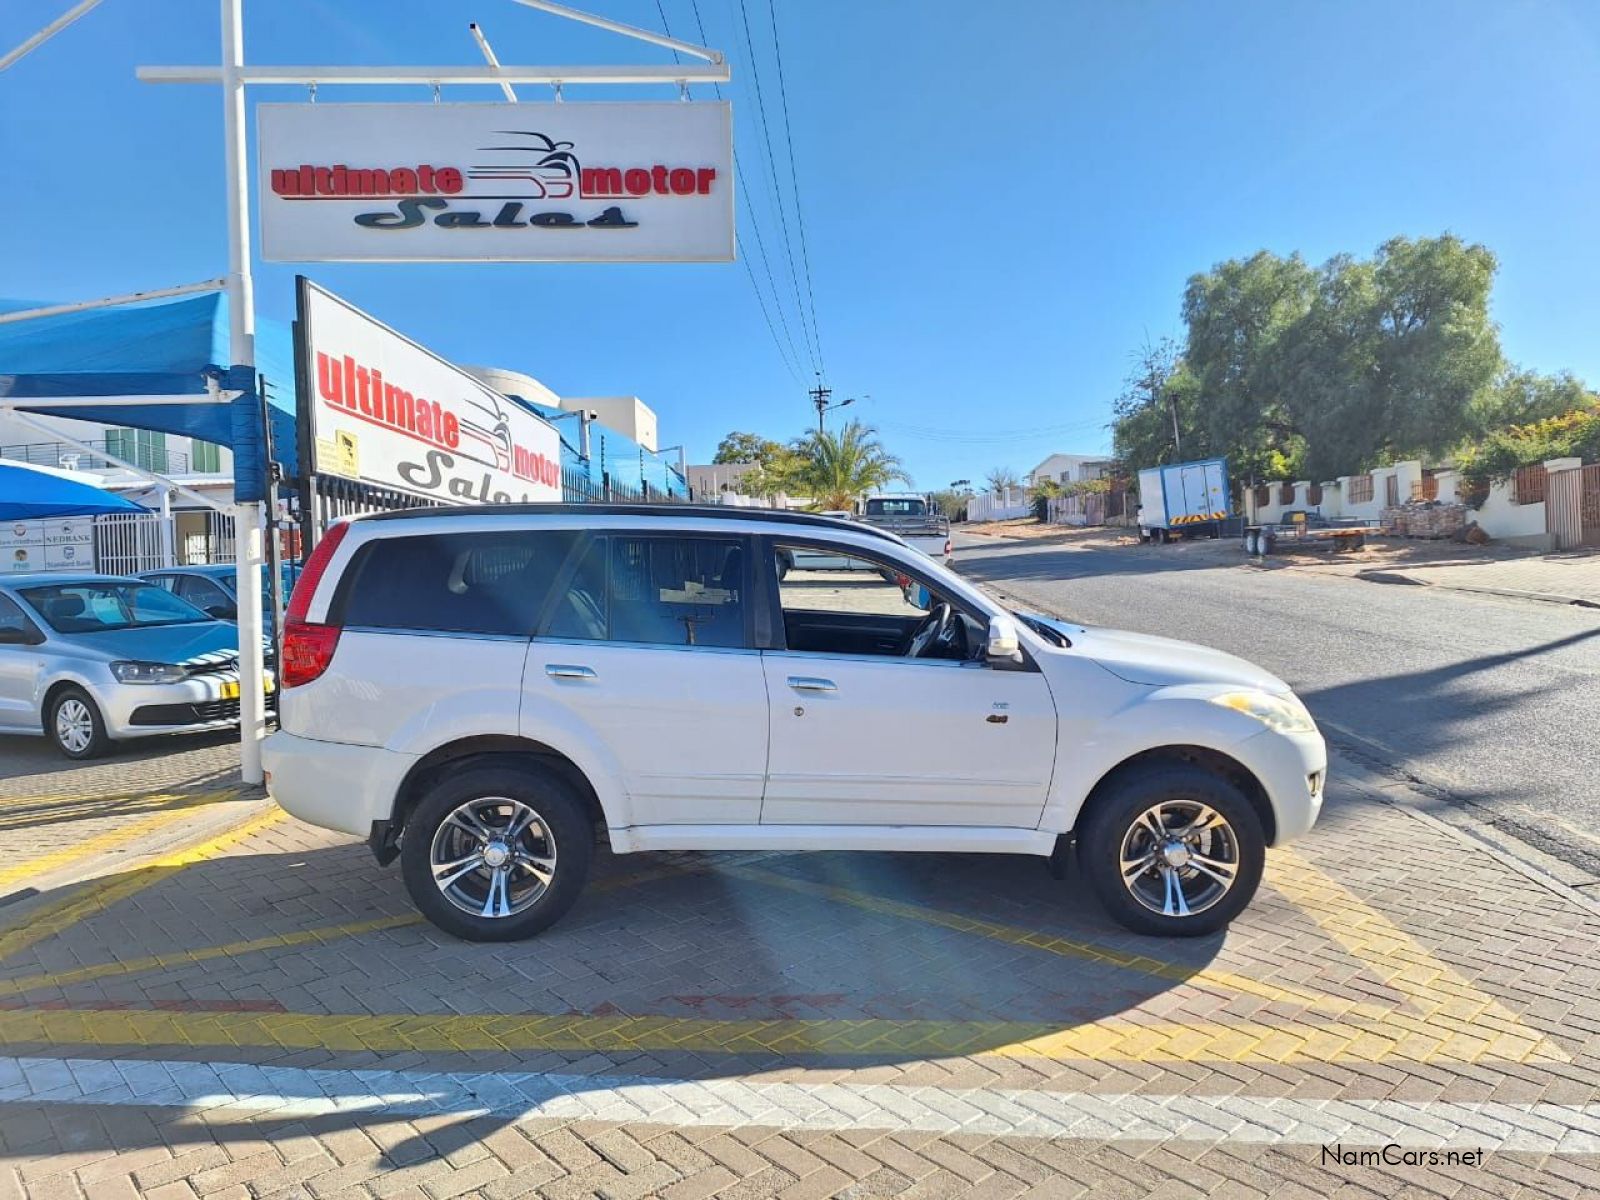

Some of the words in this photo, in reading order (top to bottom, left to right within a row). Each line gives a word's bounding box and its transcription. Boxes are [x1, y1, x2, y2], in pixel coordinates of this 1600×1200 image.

[271, 164, 463, 197] ultimate
[581, 164, 716, 195] motor
[355, 198, 638, 229] Sales
[317, 351, 460, 449] ultimate
[514, 443, 560, 489] motor
[46, 535, 90, 543] NEDBANK
